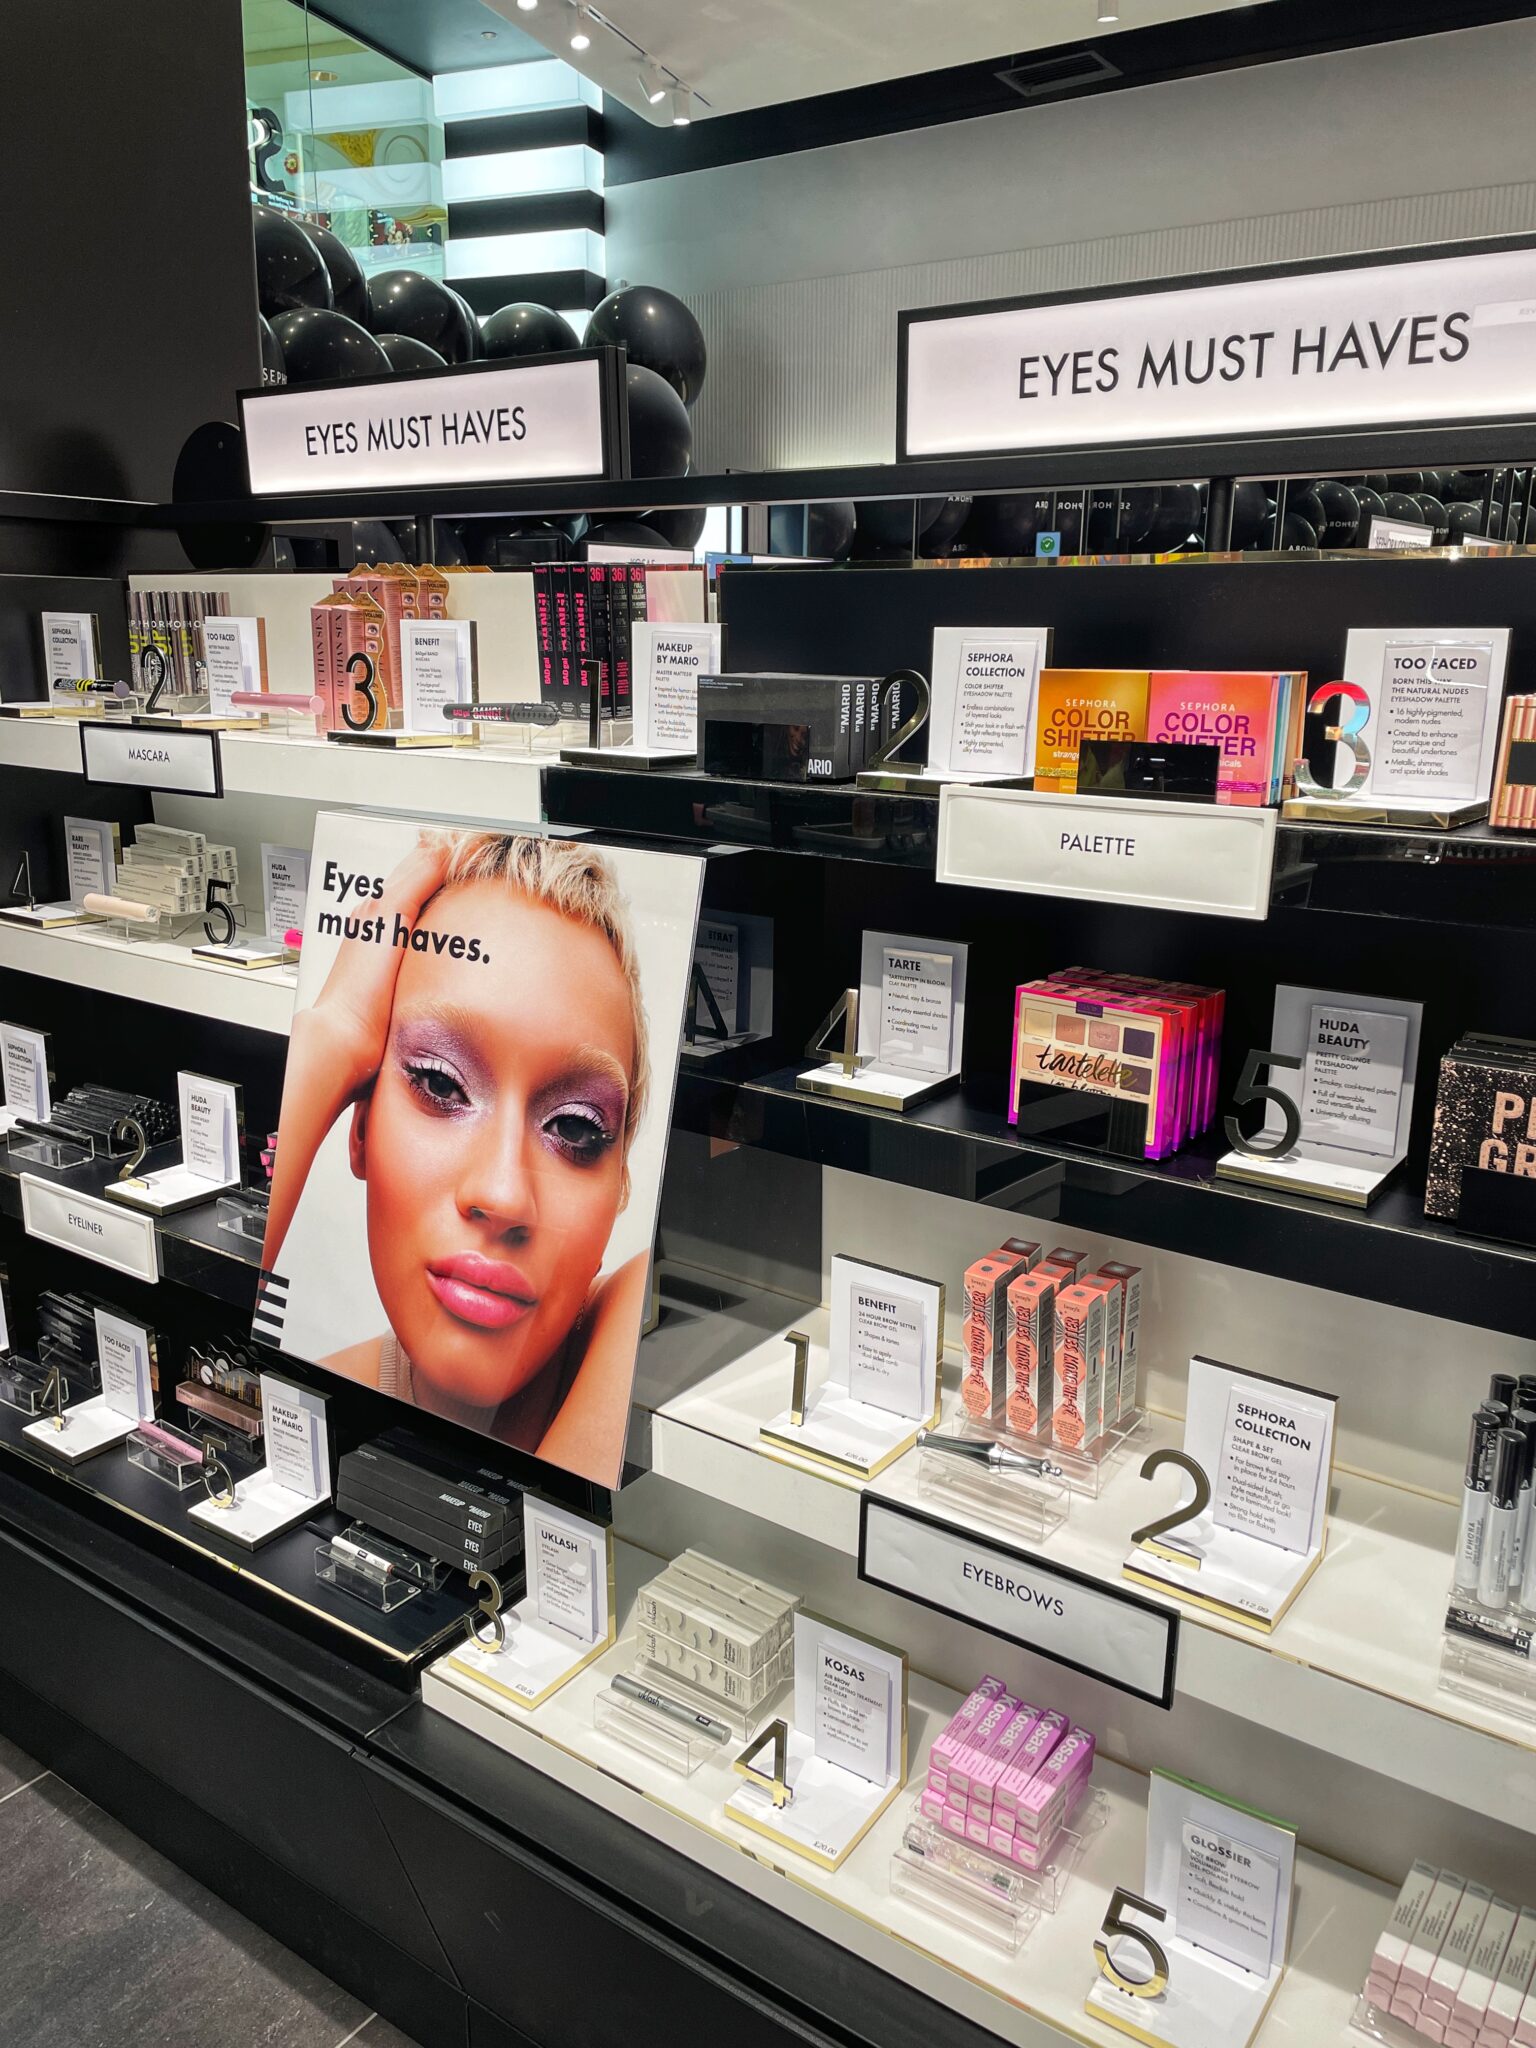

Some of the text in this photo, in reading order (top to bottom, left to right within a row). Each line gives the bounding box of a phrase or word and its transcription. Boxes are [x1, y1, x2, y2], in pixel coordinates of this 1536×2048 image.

[1018, 310, 1472, 399] EYES MUST HAVES
[305, 406, 527, 456] EYES MUST HAVES
[415, 638, 440, 646] BENEFIT
[657, 643, 693, 652] MAKEUP
[657, 655, 699, 666] BY MARIO
[967, 653, 1013, 662] SEPHORA
[1394, 658, 1477, 669] TOO FACED
[142, 644, 173, 715] 2
[966, 668, 1025, 677] COLLECTION
[342, 652, 377, 731] 3
[892, 682, 901, 722] MARIO
[841, 684, 850, 726] MARIO
[855, 684, 865, 725] MARIO
[871, 683, 880, 723] MARIO
[1065, 698, 1116, 708] SEPHORA
[1180, 702, 1236, 712] SEPHORA
[867, 669, 932, 774] 2
[1051, 708, 1130, 729] COLOR
[1164, 712, 1250, 734] COLOR
[1294, 680, 1371, 799] 3
[1394, 729, 1420, 737] Created
[128, 748, 170, 763] MASCARA
[1427, 768, 1448, 776] shades
[1061, 832, 1136, 857] PALETTE
[323, 860, 384, 903] Eyes
[203, 878, 236, 948] 5
[317, 912, 385, 944] must
[392, 913, 490, 965] haves.
[888, 958, 921, 971] TARTE
[804, 988, 863, 1080] 4
[1320, 1019, 1359, 1033] HUDA
[1318, 1033, 1370, 1049] BEAUTY
[8, 1052, 32, 1064] COLLECTION
[1036, 1044, 1139, 1087] tartelette
[1315, 1060, 1359, 1070] EYESHADOW
[1316, 1051, 1371, 1064] PRETTY GRUNGE
[1315, 1067, 1337, 1075] PALETTE
[191, 1095, 207, 1104] HUDA
[191, 1104, 211, 1114] BEAUTY
[1223, 1048, 1302, 1160] 5
[1336, 1094, 1365, 1103] wearable
[1356, 1104, 1377, 1113] shades
[117, 1116, 150, 1189] 2
[68, 1212, 104, 1237] EYELINER
[859, 1296, 896, 1314] BENEFIT
[866, 1313, 881, 1321] HOUR
[882, 1317, 899, 1325] BROW
[900, 1322, 916, 1331] SETTER
[971, 1290, 986, 1357] BROW SETTER
[104, 1335, 114, 1346] TOO
[116, 1341, 131, 1353] FACED
[1015, 1306, 1031, 1372] BROW SETTER
[1063, 1316, 1080, 1384] BROW SETTER
[783, 1330, 810, 1427] 1
[272, 1406, 298, 1420] MAKEUP
[272, 1415, 303, 1432] BY MARIO
[1237, 1403, 1296, 1430] SEPHORA
[1233, 1436, 1254, 1448] SHAPE
[1262, 1445, 1274, 1454] SET
[1235, 1418, 1311, 1451] COLLECTION
[1232, 1444, 1283, 1466] CLEAR BROW GEL
[200, 1434, 235, 1509] 5
[1235, 1456, 1245, 1466] For
[1246, 1459, 1264, 1472] brows
[1278, 1471, 1290, 1481] stay
[1241, 1468, 1295, 1490] place for 24 hours
[439, 1494, 466, 1507] MAKEUP
[1130, 1448, 1212, 1571] 2
[1229, 1503, 1262, 1520] Strong hold
[468, 1519, 483, 1534] EYES
[464, 1539, 480, 1553] EYES
[541, 1530, 577, 1552] UKLASH
[464, 1559, 478, 1571] EYES
[963, 1562, 1065, 1617] EYEBROWS
[464, 1570, 506, 1654] 3
[825, 1656, 865, 1682] KOSAS
[825, 1672, 850, 1687] AIR BROW
[638, 1689, 660, 1706] uklash
[824, 1679, 883, 1708] CLEAR LIFTING TREATMENT
[834, 1689, 847, 1699] CLEAR
[962, 1678, 1002, 1718] Kosas
[977, 1693, 1018, 1736] Kosas
[1000, 1704, 1039, 1747] Kosas
[1025, 1711, 1065, 1754] Kosas
[1048, 1728, 1090, 1770] Kosas
[732, 1718, 794, 1810] 4
[1191, 1835, 1252, 1868] GLOSSIER
[1206, 1856, 1226, 1868] BROW
[1190, 1856, 1260, 1890] VOLUMIZING EYEBROW
[1092, 1885, 1170, 1999] 5
